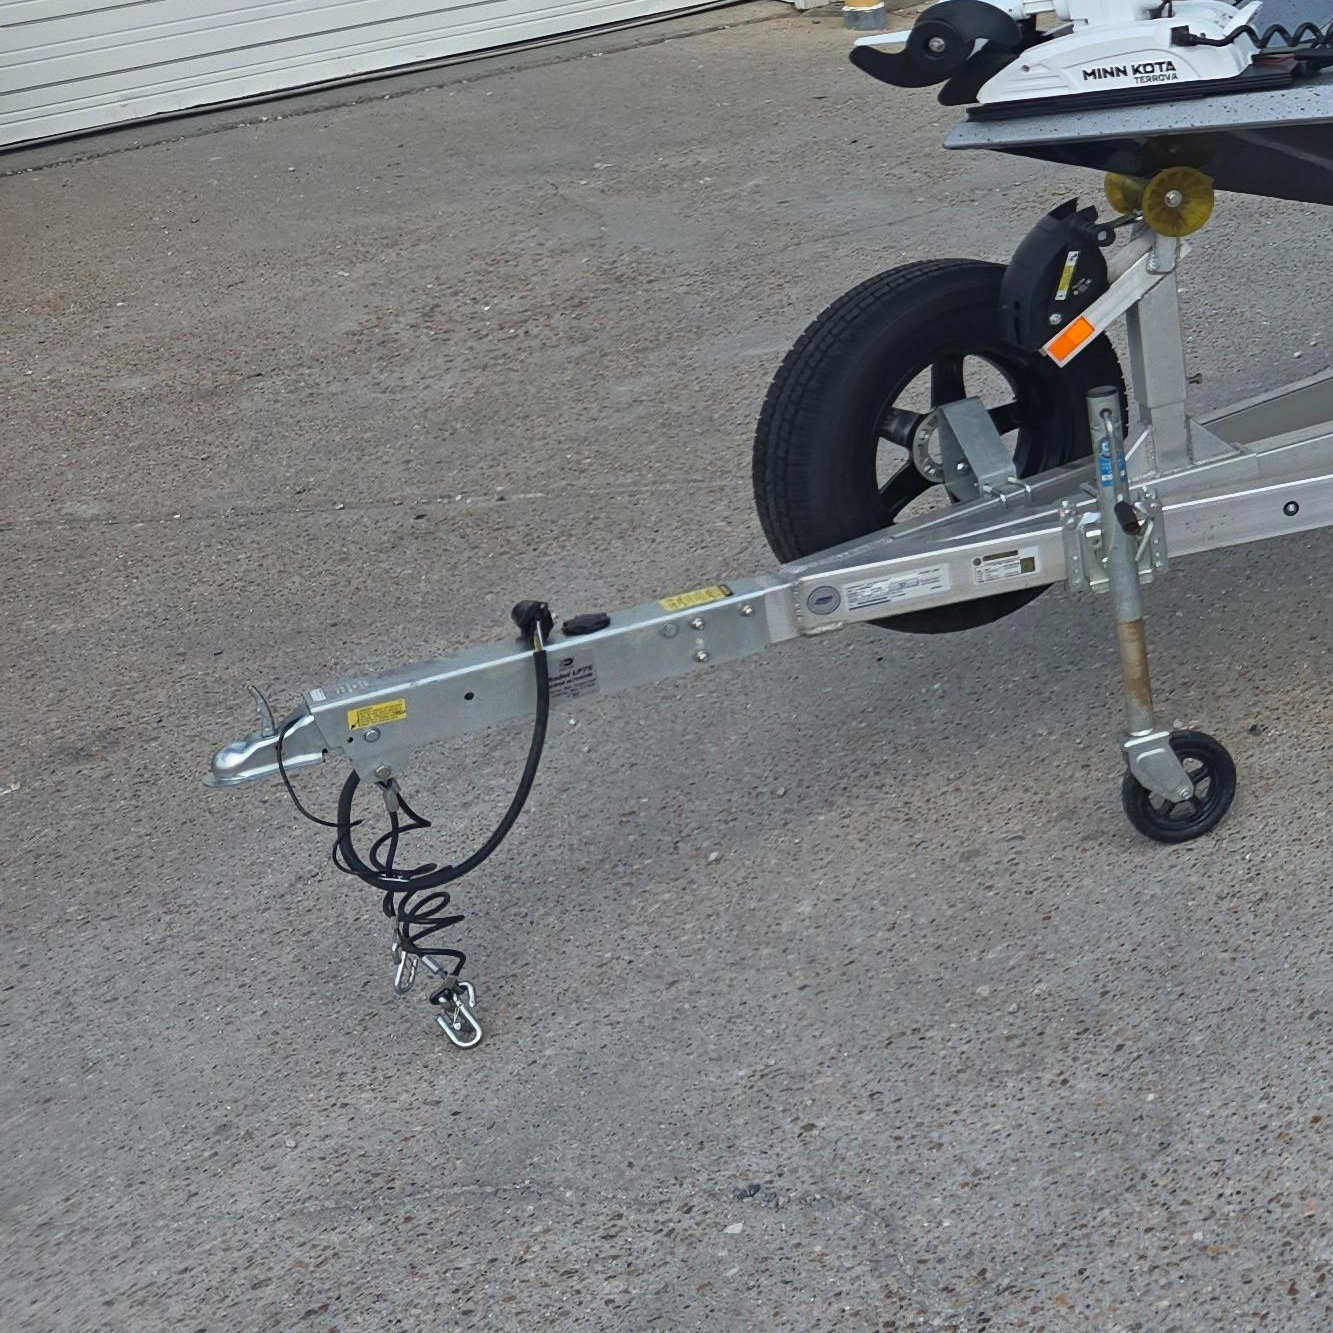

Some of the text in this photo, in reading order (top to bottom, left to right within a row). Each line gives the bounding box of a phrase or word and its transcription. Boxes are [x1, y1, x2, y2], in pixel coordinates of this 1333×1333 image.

[1082, 60, 1177, 81] MINN KOTA
[1133, 72, 1179, 84] TERROVA
